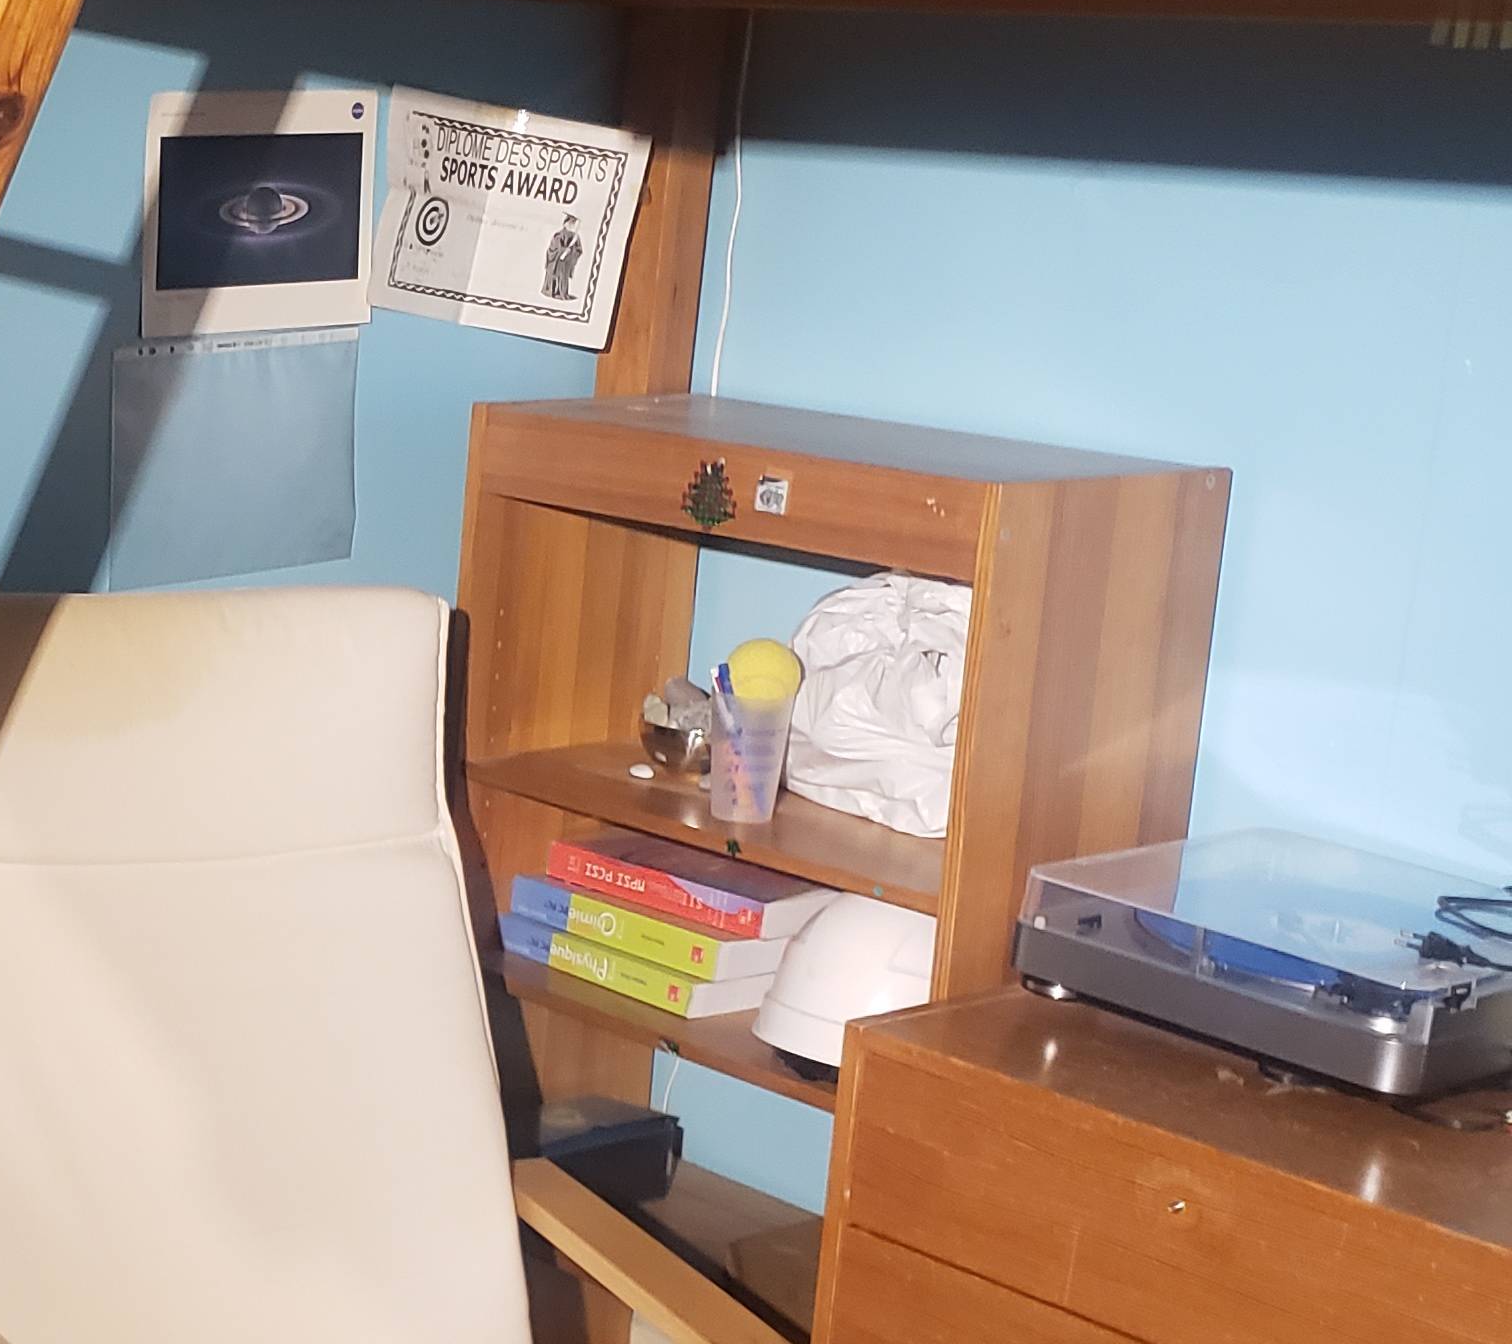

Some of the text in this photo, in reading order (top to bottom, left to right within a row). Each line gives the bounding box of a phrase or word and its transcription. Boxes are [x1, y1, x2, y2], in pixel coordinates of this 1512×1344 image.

[496, 139, 533, 168] DES
[536, 146, 609, 182] SPORTS
[440, 157, 578, 205] SPORTS AWARD
[585, 862, 614, 882] PCSI
[616, 873, 646, 892] MPSI
[568, 907, 616, 936] Chimie
[550, 942, 608, 981] Physique
